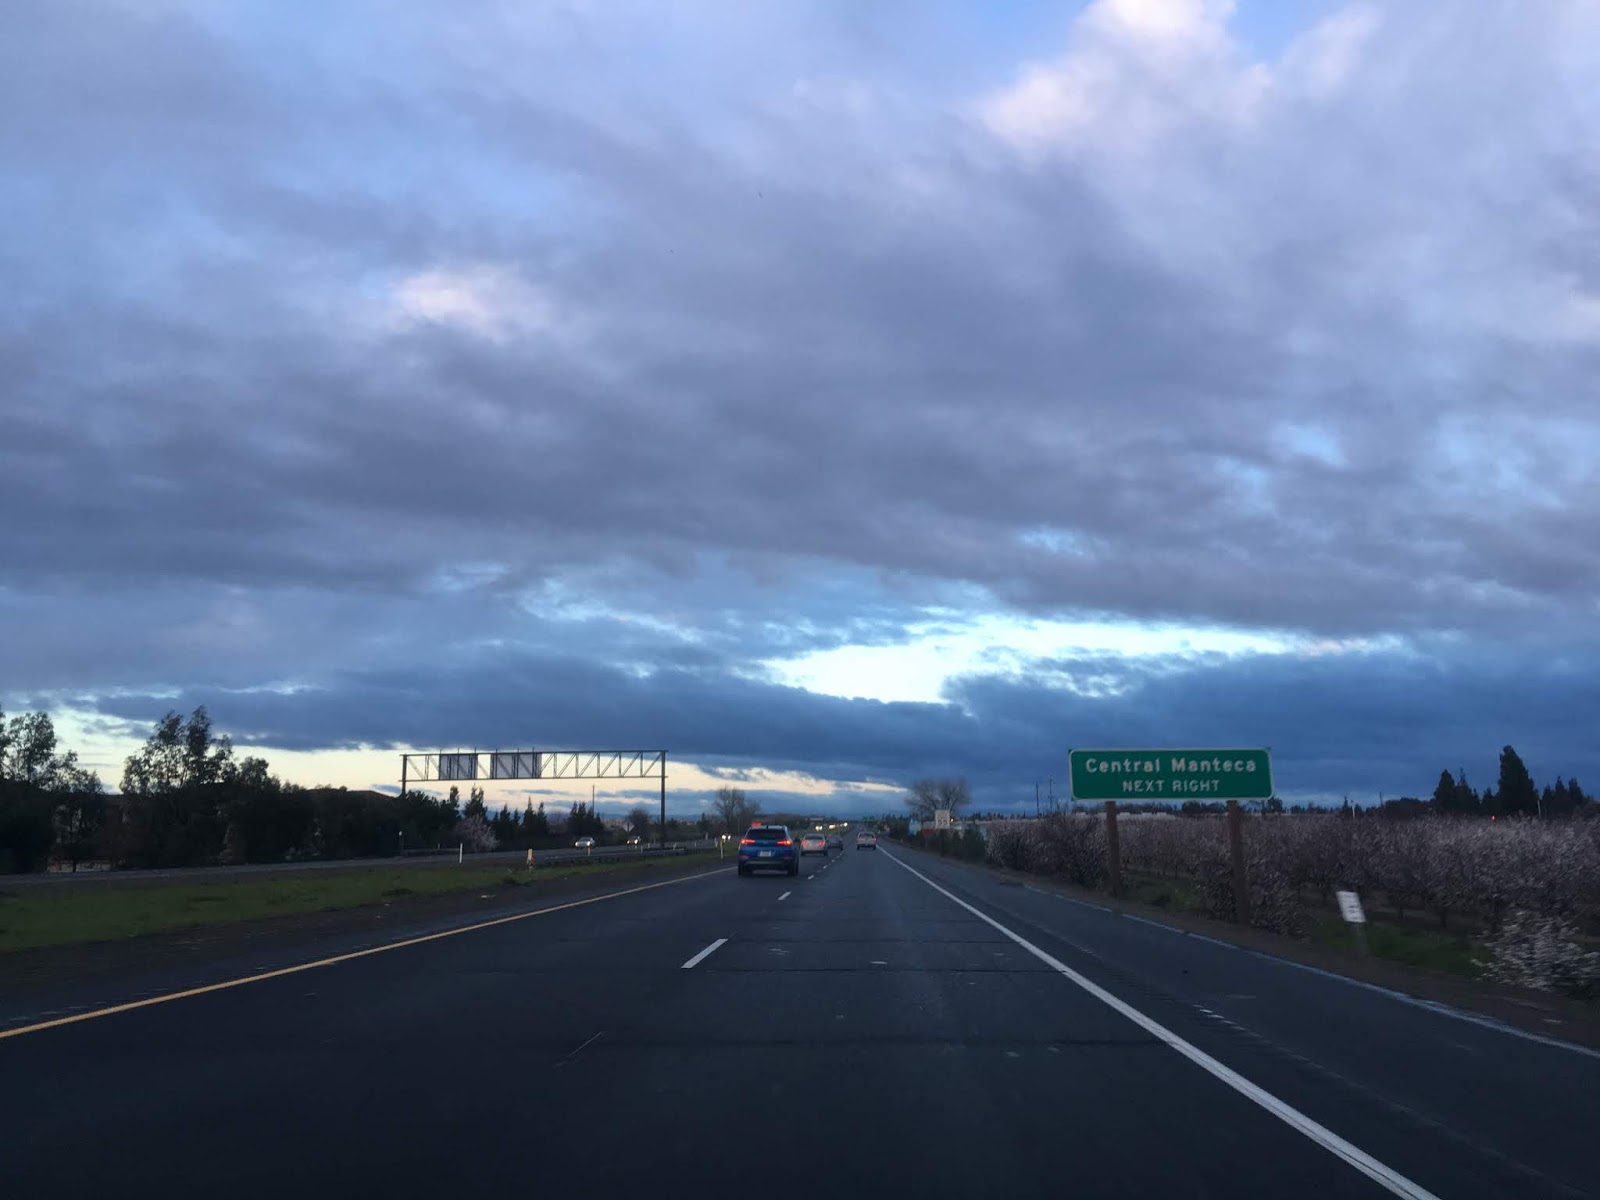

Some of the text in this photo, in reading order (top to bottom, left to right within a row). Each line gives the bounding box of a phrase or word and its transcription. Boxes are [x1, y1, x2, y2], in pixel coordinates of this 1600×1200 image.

[1085, 757, 1257, 773] Central Manteca
[1122, 779, 1220, 792] NEXT RIGHT
